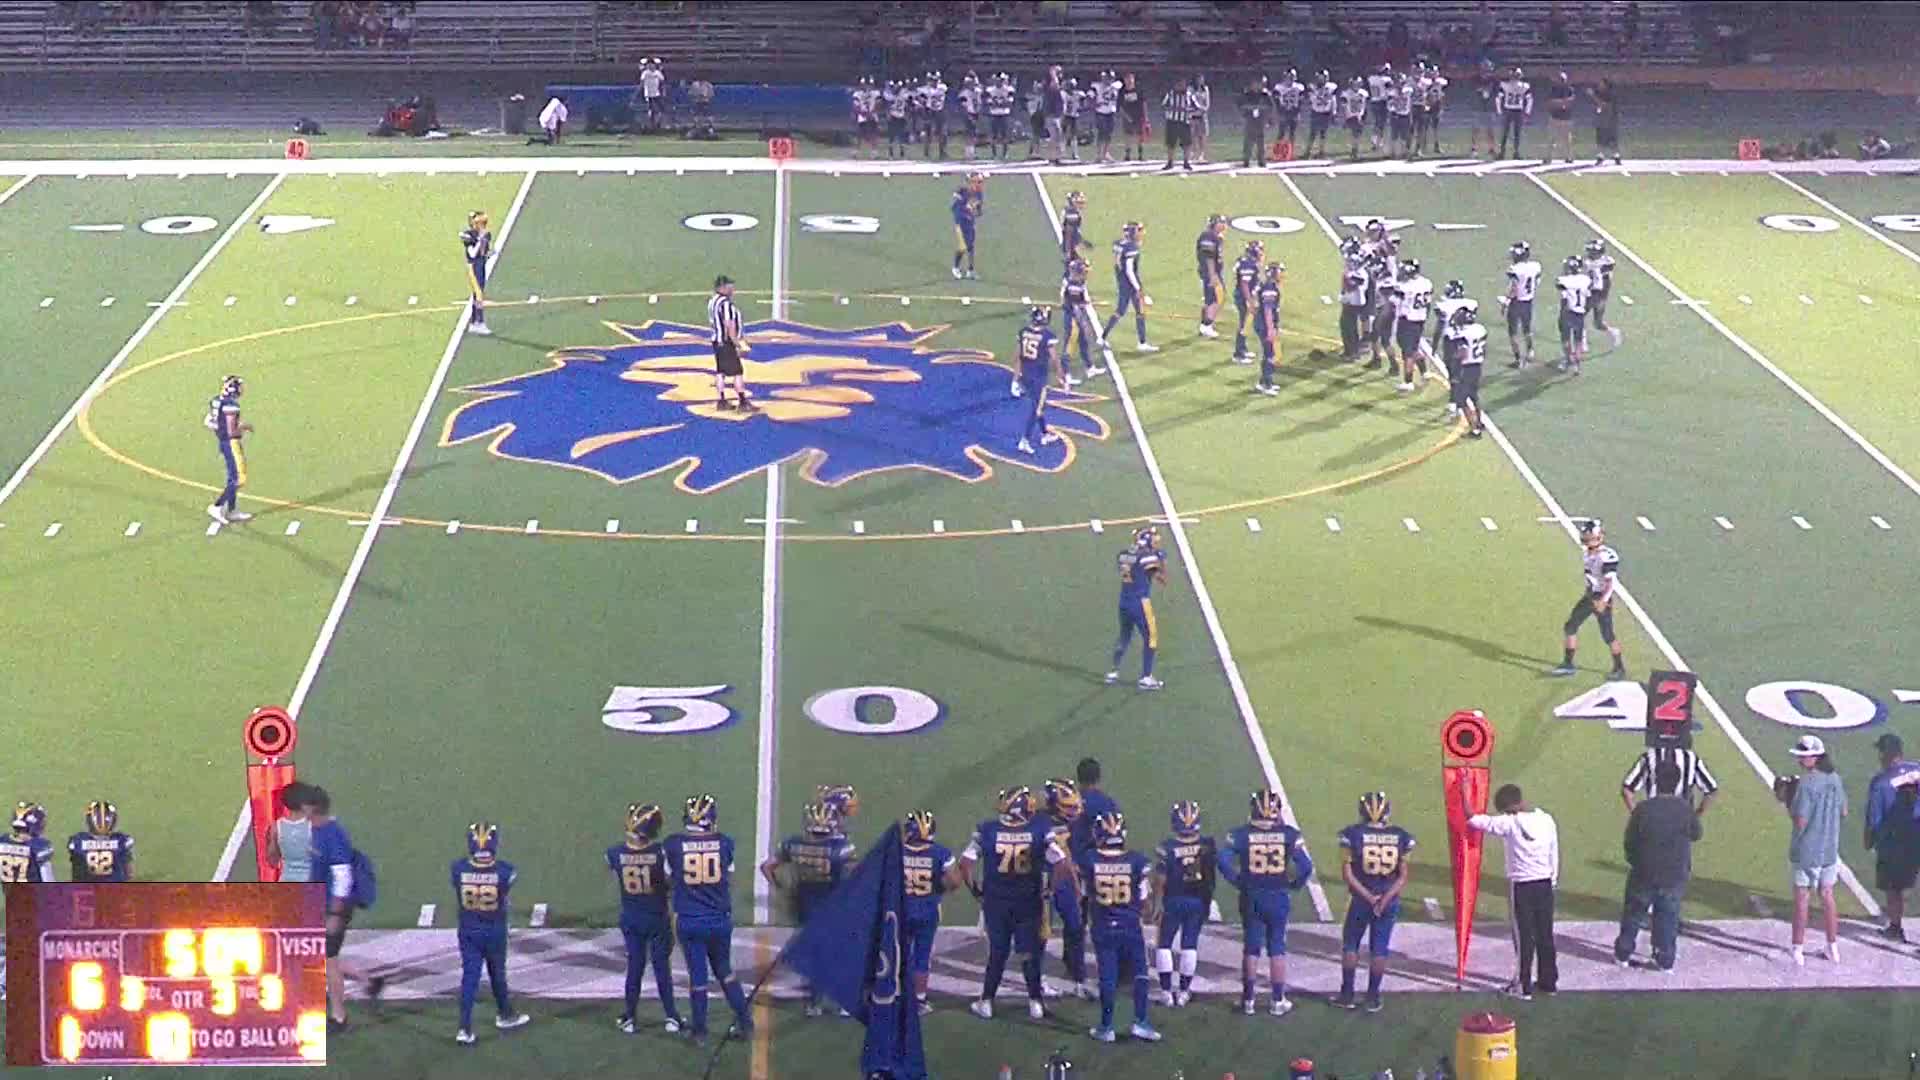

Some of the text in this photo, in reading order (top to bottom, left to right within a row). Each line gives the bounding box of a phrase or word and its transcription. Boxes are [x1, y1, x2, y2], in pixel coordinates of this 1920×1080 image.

[1654, 681, 1688, 720] 2
[683, 852, 720, 884] 90
[1249, 843, 1285, 873] 63
[1362, 845, 1398, 875] 69
